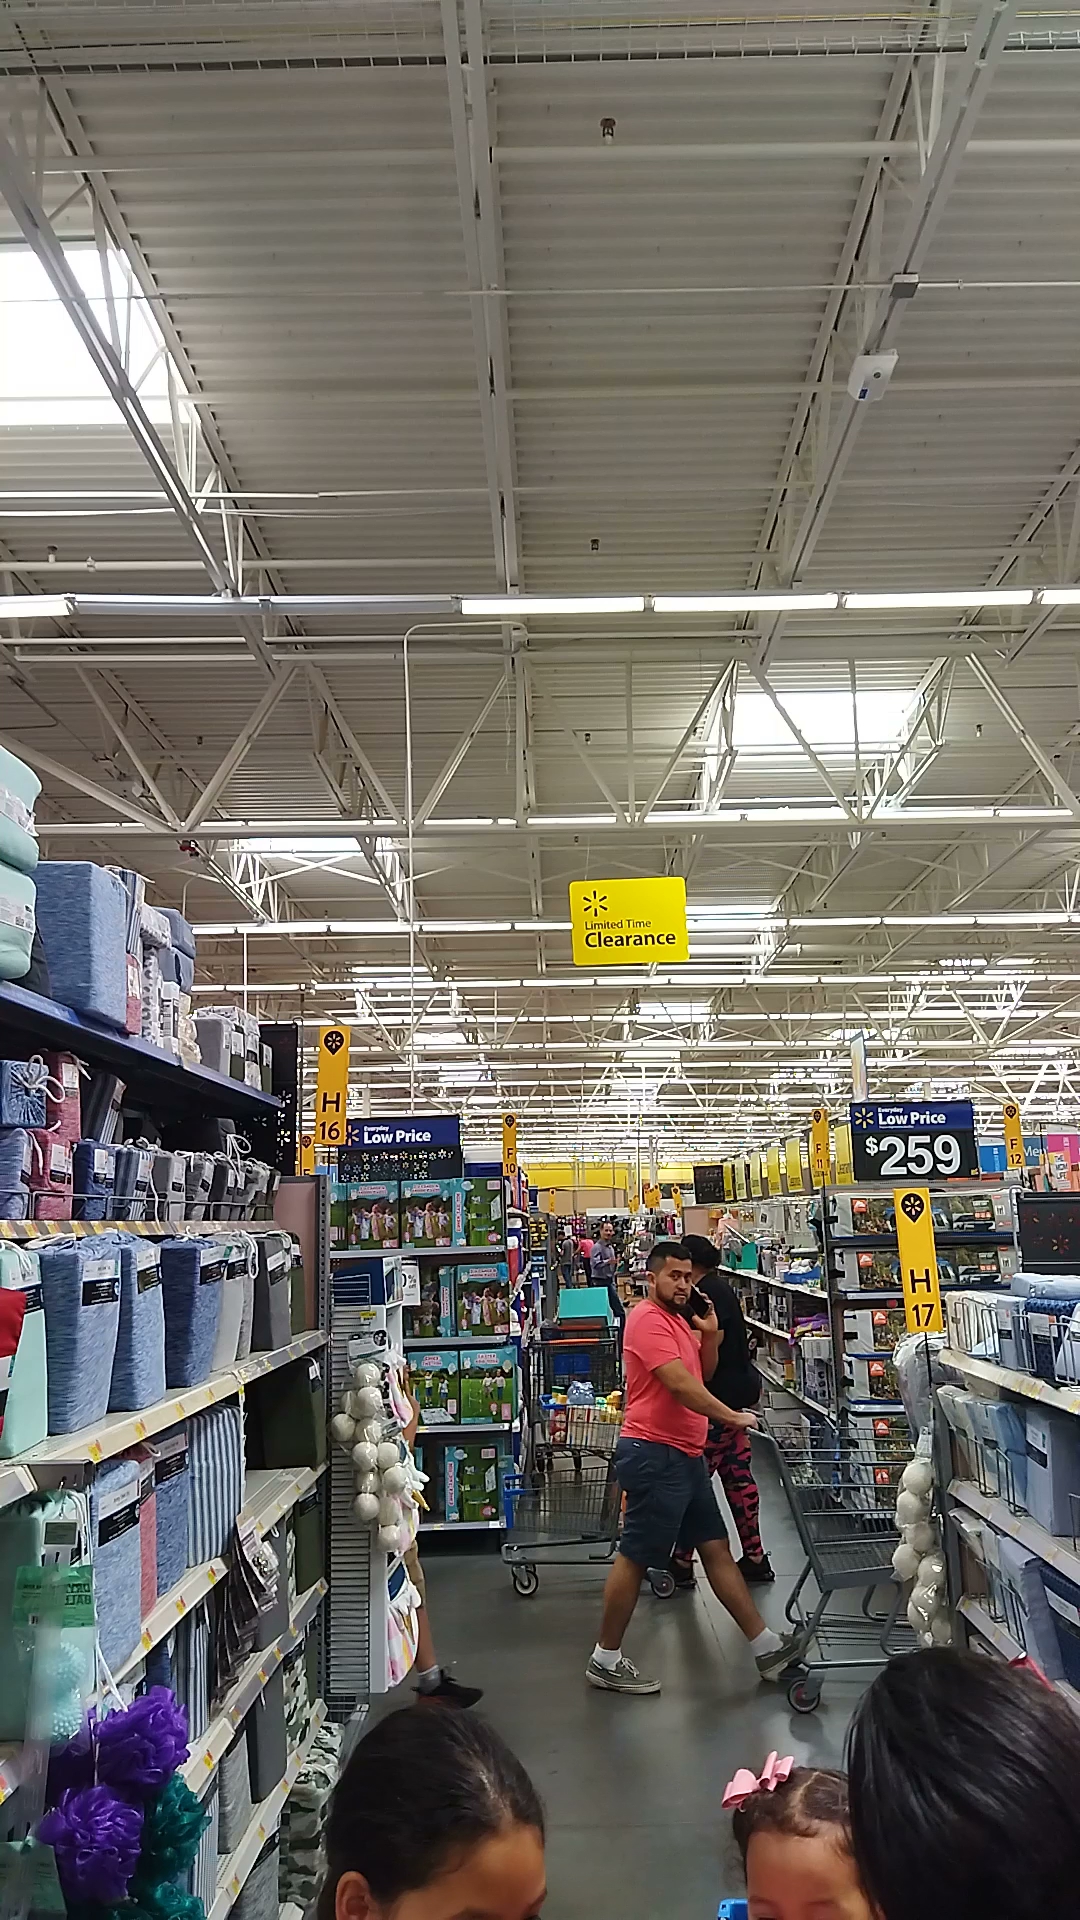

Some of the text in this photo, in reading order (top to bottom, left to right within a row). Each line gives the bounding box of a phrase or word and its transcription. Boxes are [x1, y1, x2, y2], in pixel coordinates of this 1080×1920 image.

[585, 919, 652, 930] Limited Time
[585, 931, 676, 948] Clearance
[322, 1092, 341, 1113] H
[878, 1110, 947, 1125] Low Price
[319, 1121, 340, 1141] 16
[363, 1129, 431, 1144] Low Price
[816, 1143, 822, 1154] F
[1010, 1138, 1018, 1150] F
[507, 1147, 514, 1159] F
[865, 1134, 961, 1176] $259
[1010, 1154, 1022, 1165] 12
[505, 1162, 516, 1174] 10
[910, 1268, 932, 1294] H
[911, 1303, 935, 1327] 17
